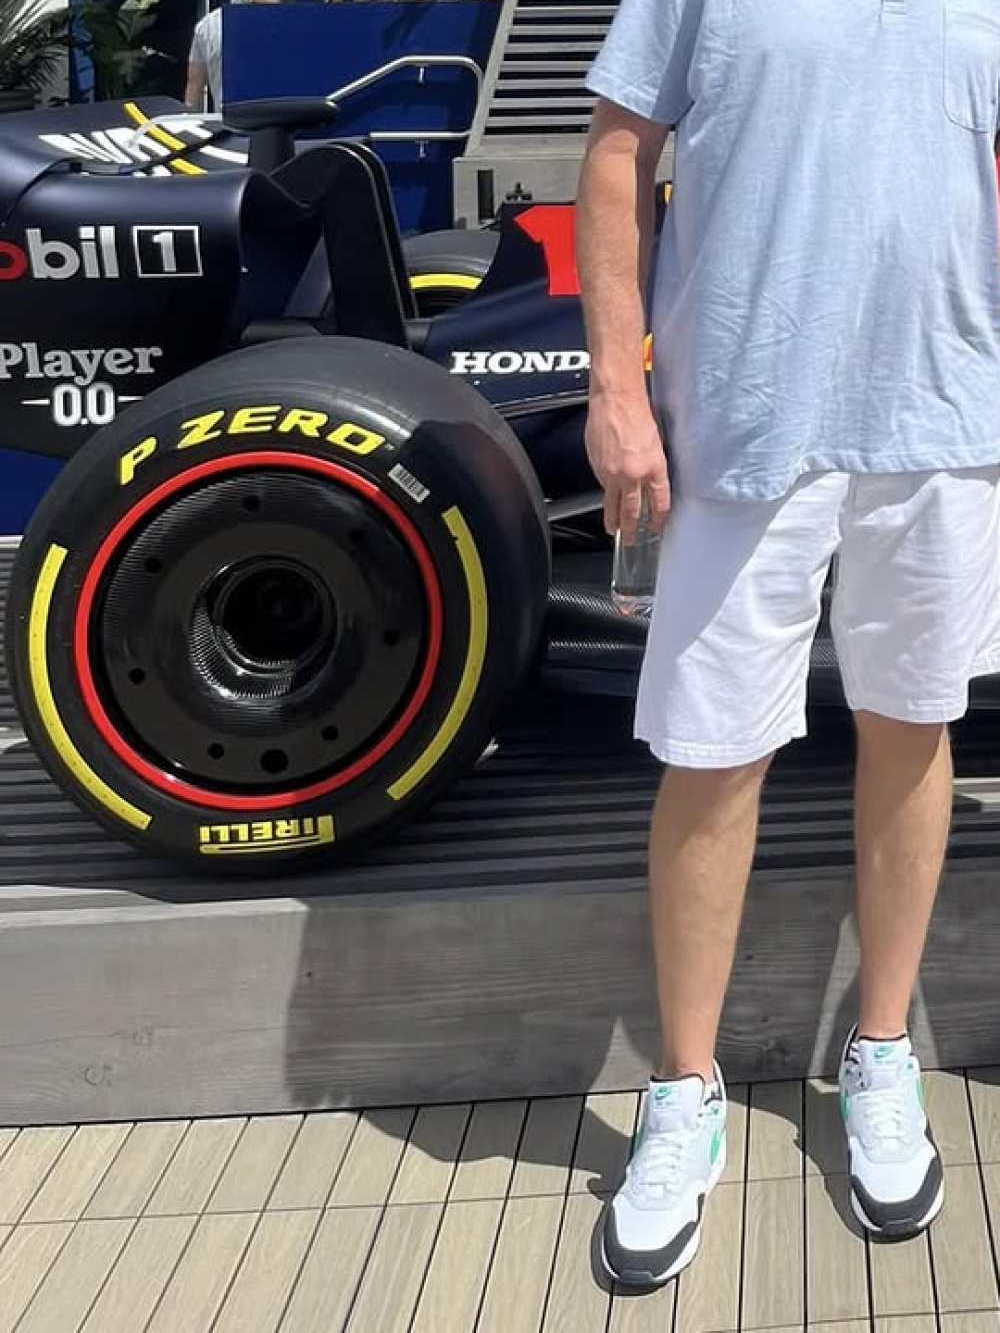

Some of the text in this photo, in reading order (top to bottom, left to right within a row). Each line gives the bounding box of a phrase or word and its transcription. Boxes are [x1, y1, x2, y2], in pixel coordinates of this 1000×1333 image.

[0, 341, 164, 386] Player
[450, 351, 591, 374] HOND
[53, 383, 116, 427] 0.0
[120, 404, 387, 486] P ZERO
[199, 814, 336, 855] PIRELLI
